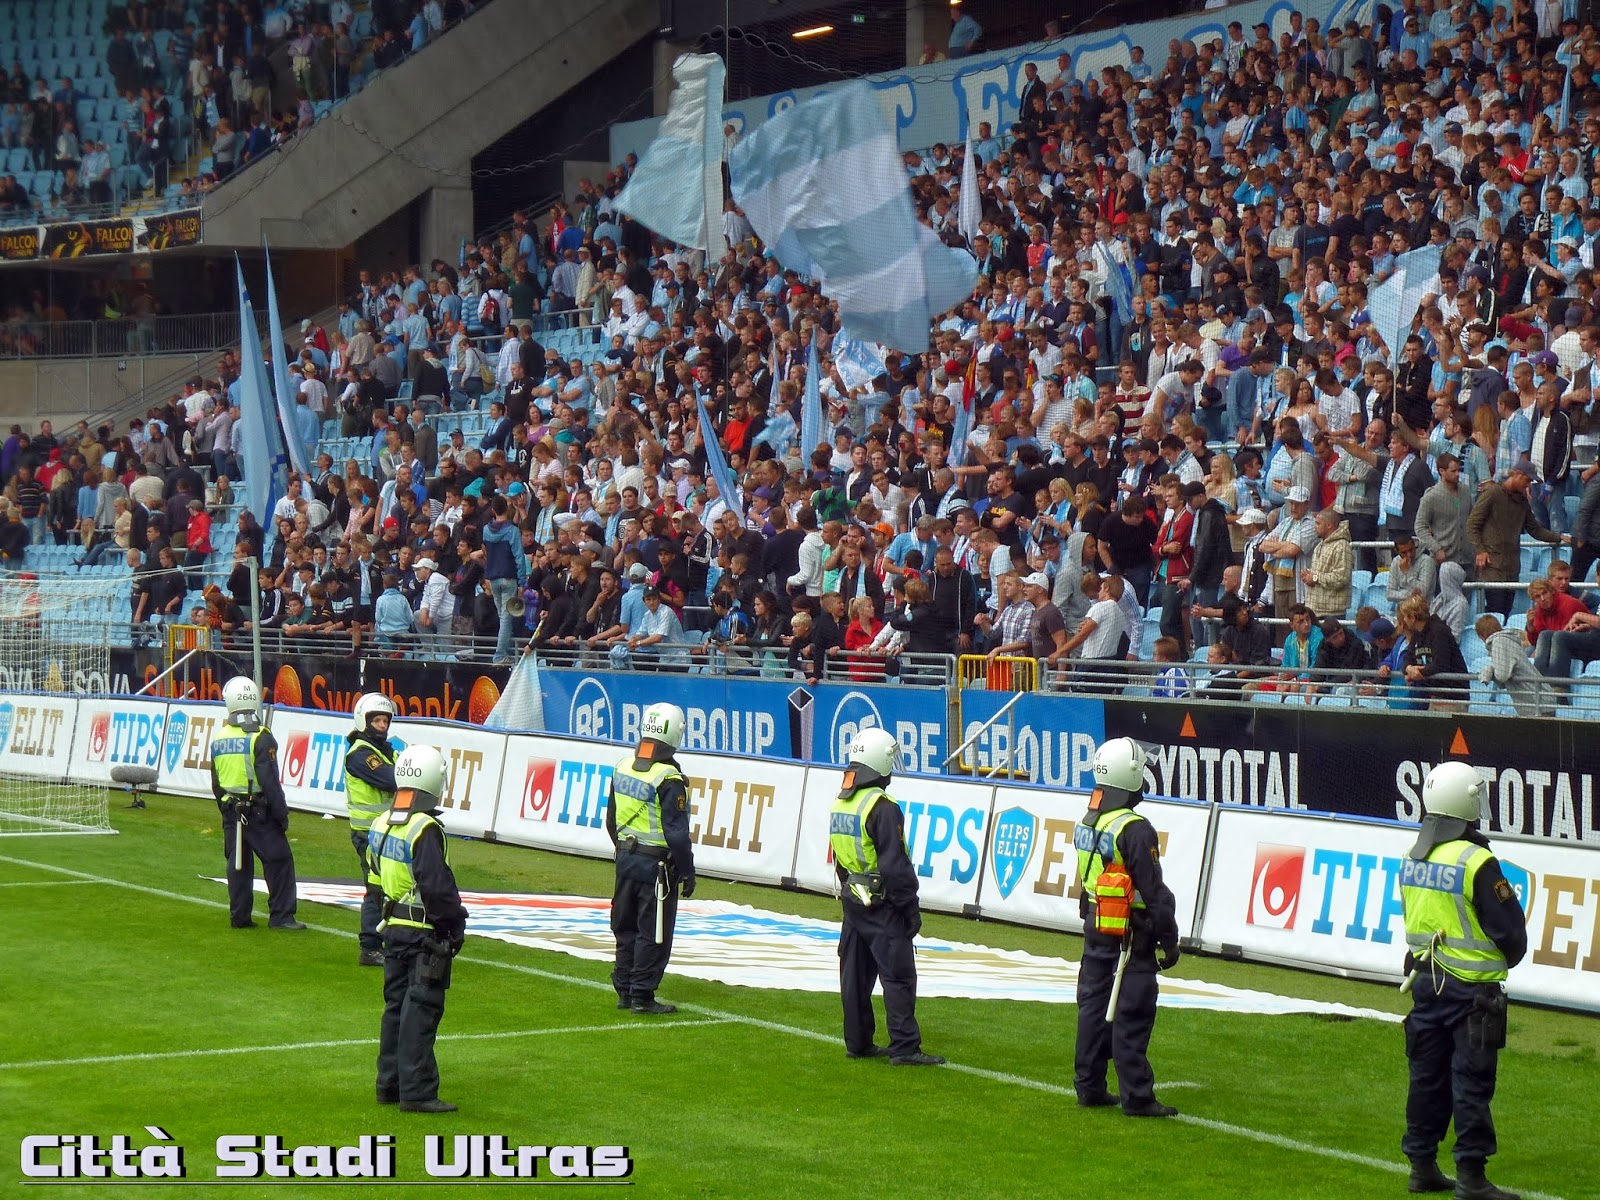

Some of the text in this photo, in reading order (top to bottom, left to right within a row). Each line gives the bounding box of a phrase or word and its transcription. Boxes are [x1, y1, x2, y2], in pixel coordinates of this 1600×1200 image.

[1, 234, 38, 250] FALCON
[96, 226, 133, 242] FALCON
[72, 671, 131, 695] SOVA
[237, 693, 257, 701] 2643
[310, 674, 462, 718] Swbank
[169, 721, 185, 733] TIPS
[648, 716, 656, 724] M
[676, 706, 775, 754] ROUP
[10, 706, 64, 758] ELIT
[110, 711, 164, 767] TIPS
[168, 733, 182, 745] ELIT
[214, 738, 245, 753] POLIS
[896, 720, 1095, 788] BE GROUP
[396, 766, 422, 778] 2800
[403, 758, 413, 767] M
[557, 760, 613, 829] TIP
[1426, 778, 1434, 789] M
[1395, 759, 1600, 842] STOTAL
[831, 813, 855, 835] OLIS
[1000, 823, 1030, 841] TIPS
[371, 832, 405, 861] PLIS
[997, 840, 1028, 858] ELIT
[1075, 827, 1110, 854] POLS
[1403, 859, 1456, 890] POLIS
[1311, 848, 1403, 945] TIP
